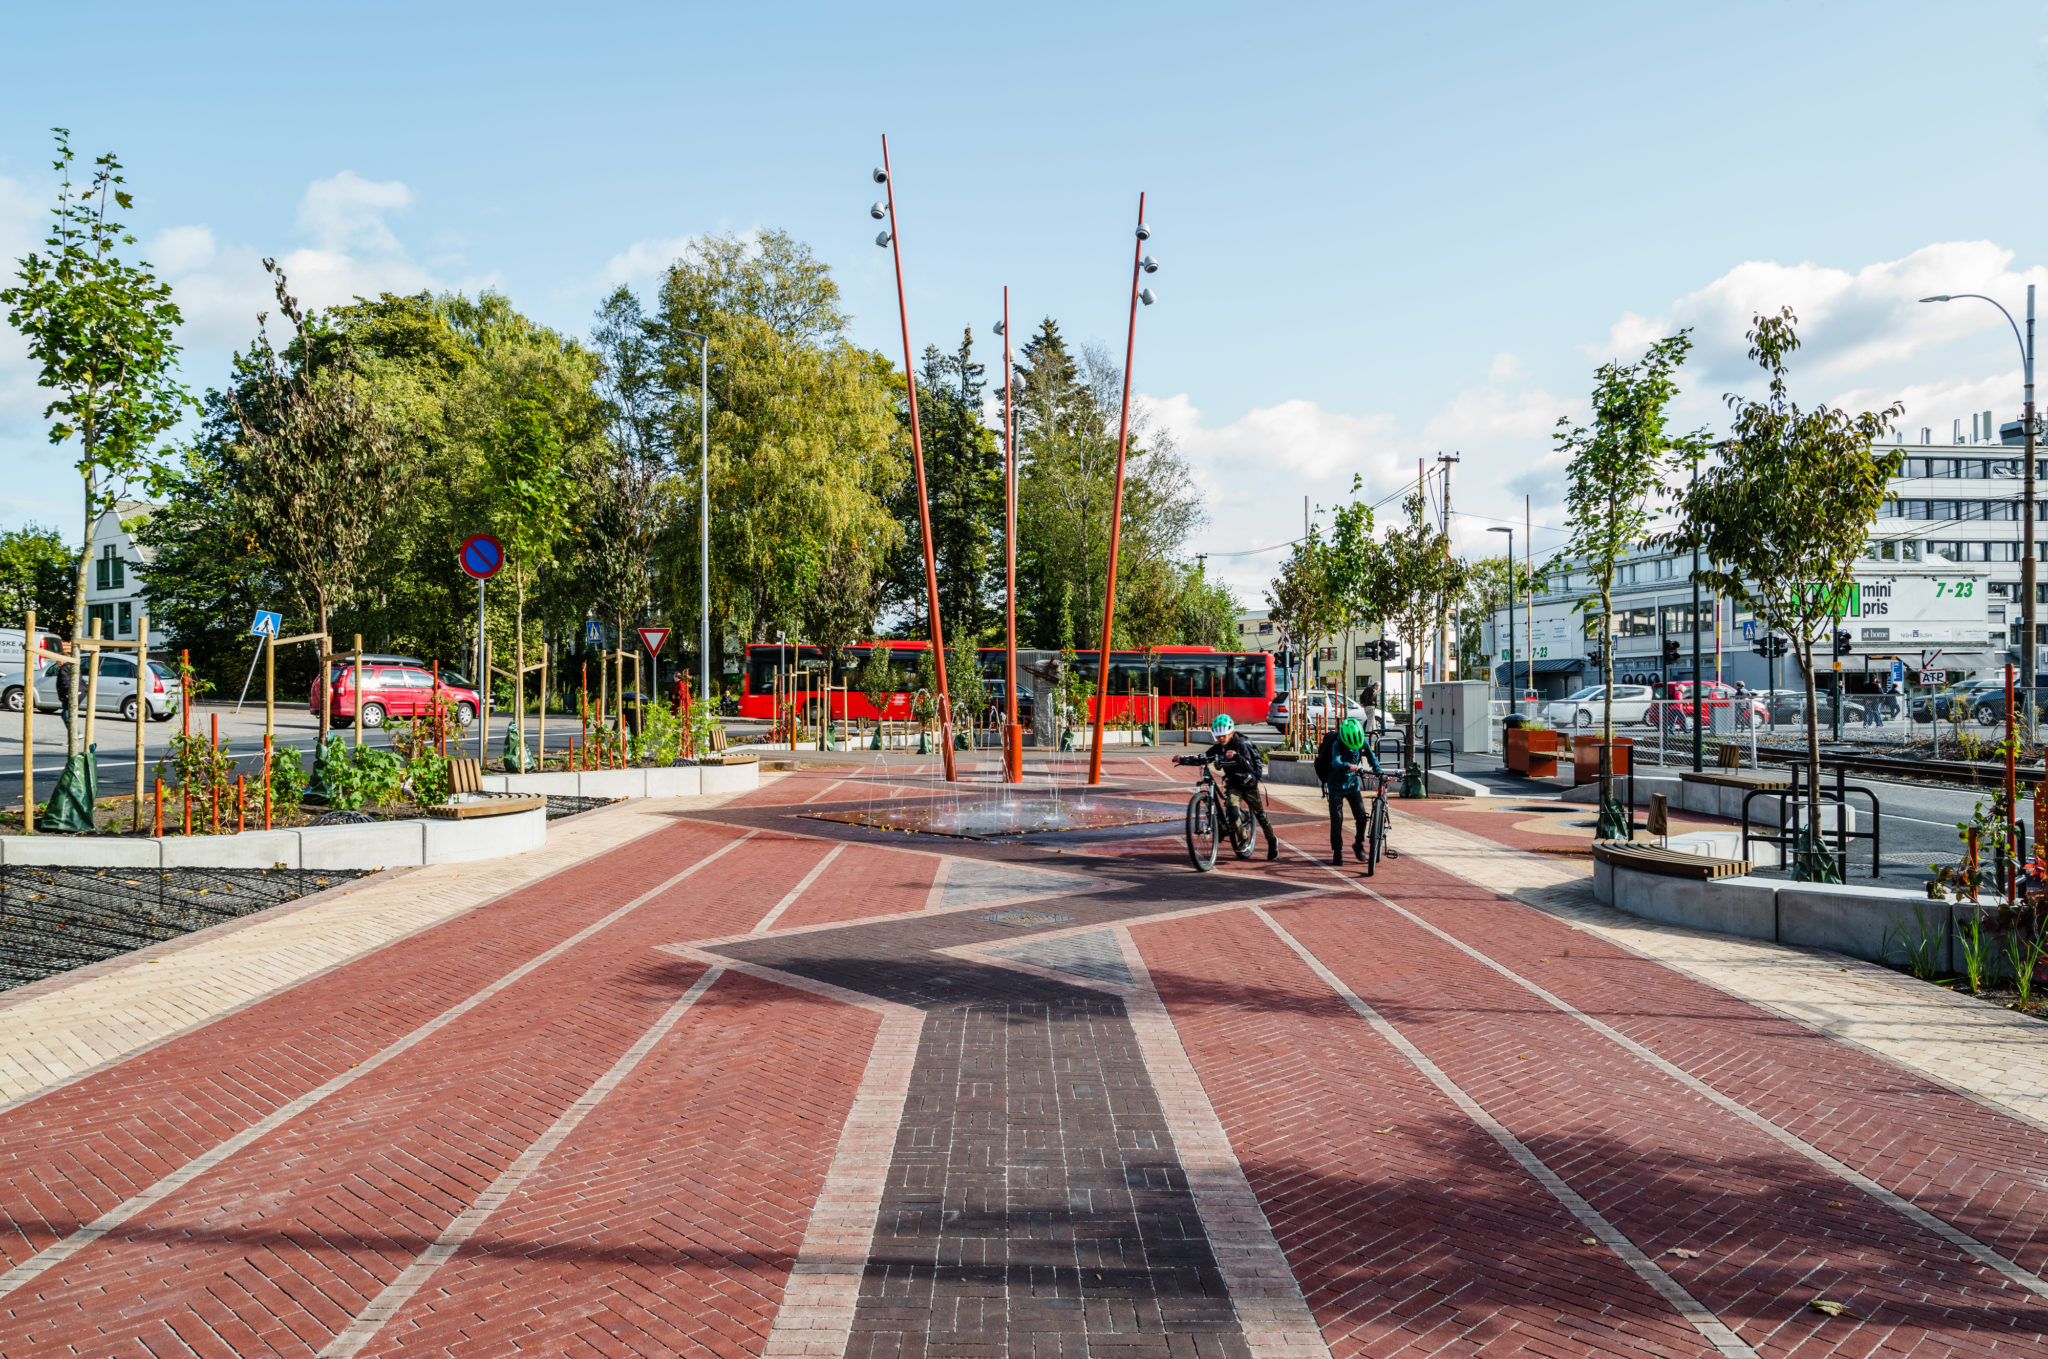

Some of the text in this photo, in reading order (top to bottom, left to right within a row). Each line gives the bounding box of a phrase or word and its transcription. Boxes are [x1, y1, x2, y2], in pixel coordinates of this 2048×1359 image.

[1863, 581, 1891, 597] mini
[1863, 598, 1888, 618] pris
[1870, 629, 1889, 638] home
[1922, 672, 1944, 682] ATP
